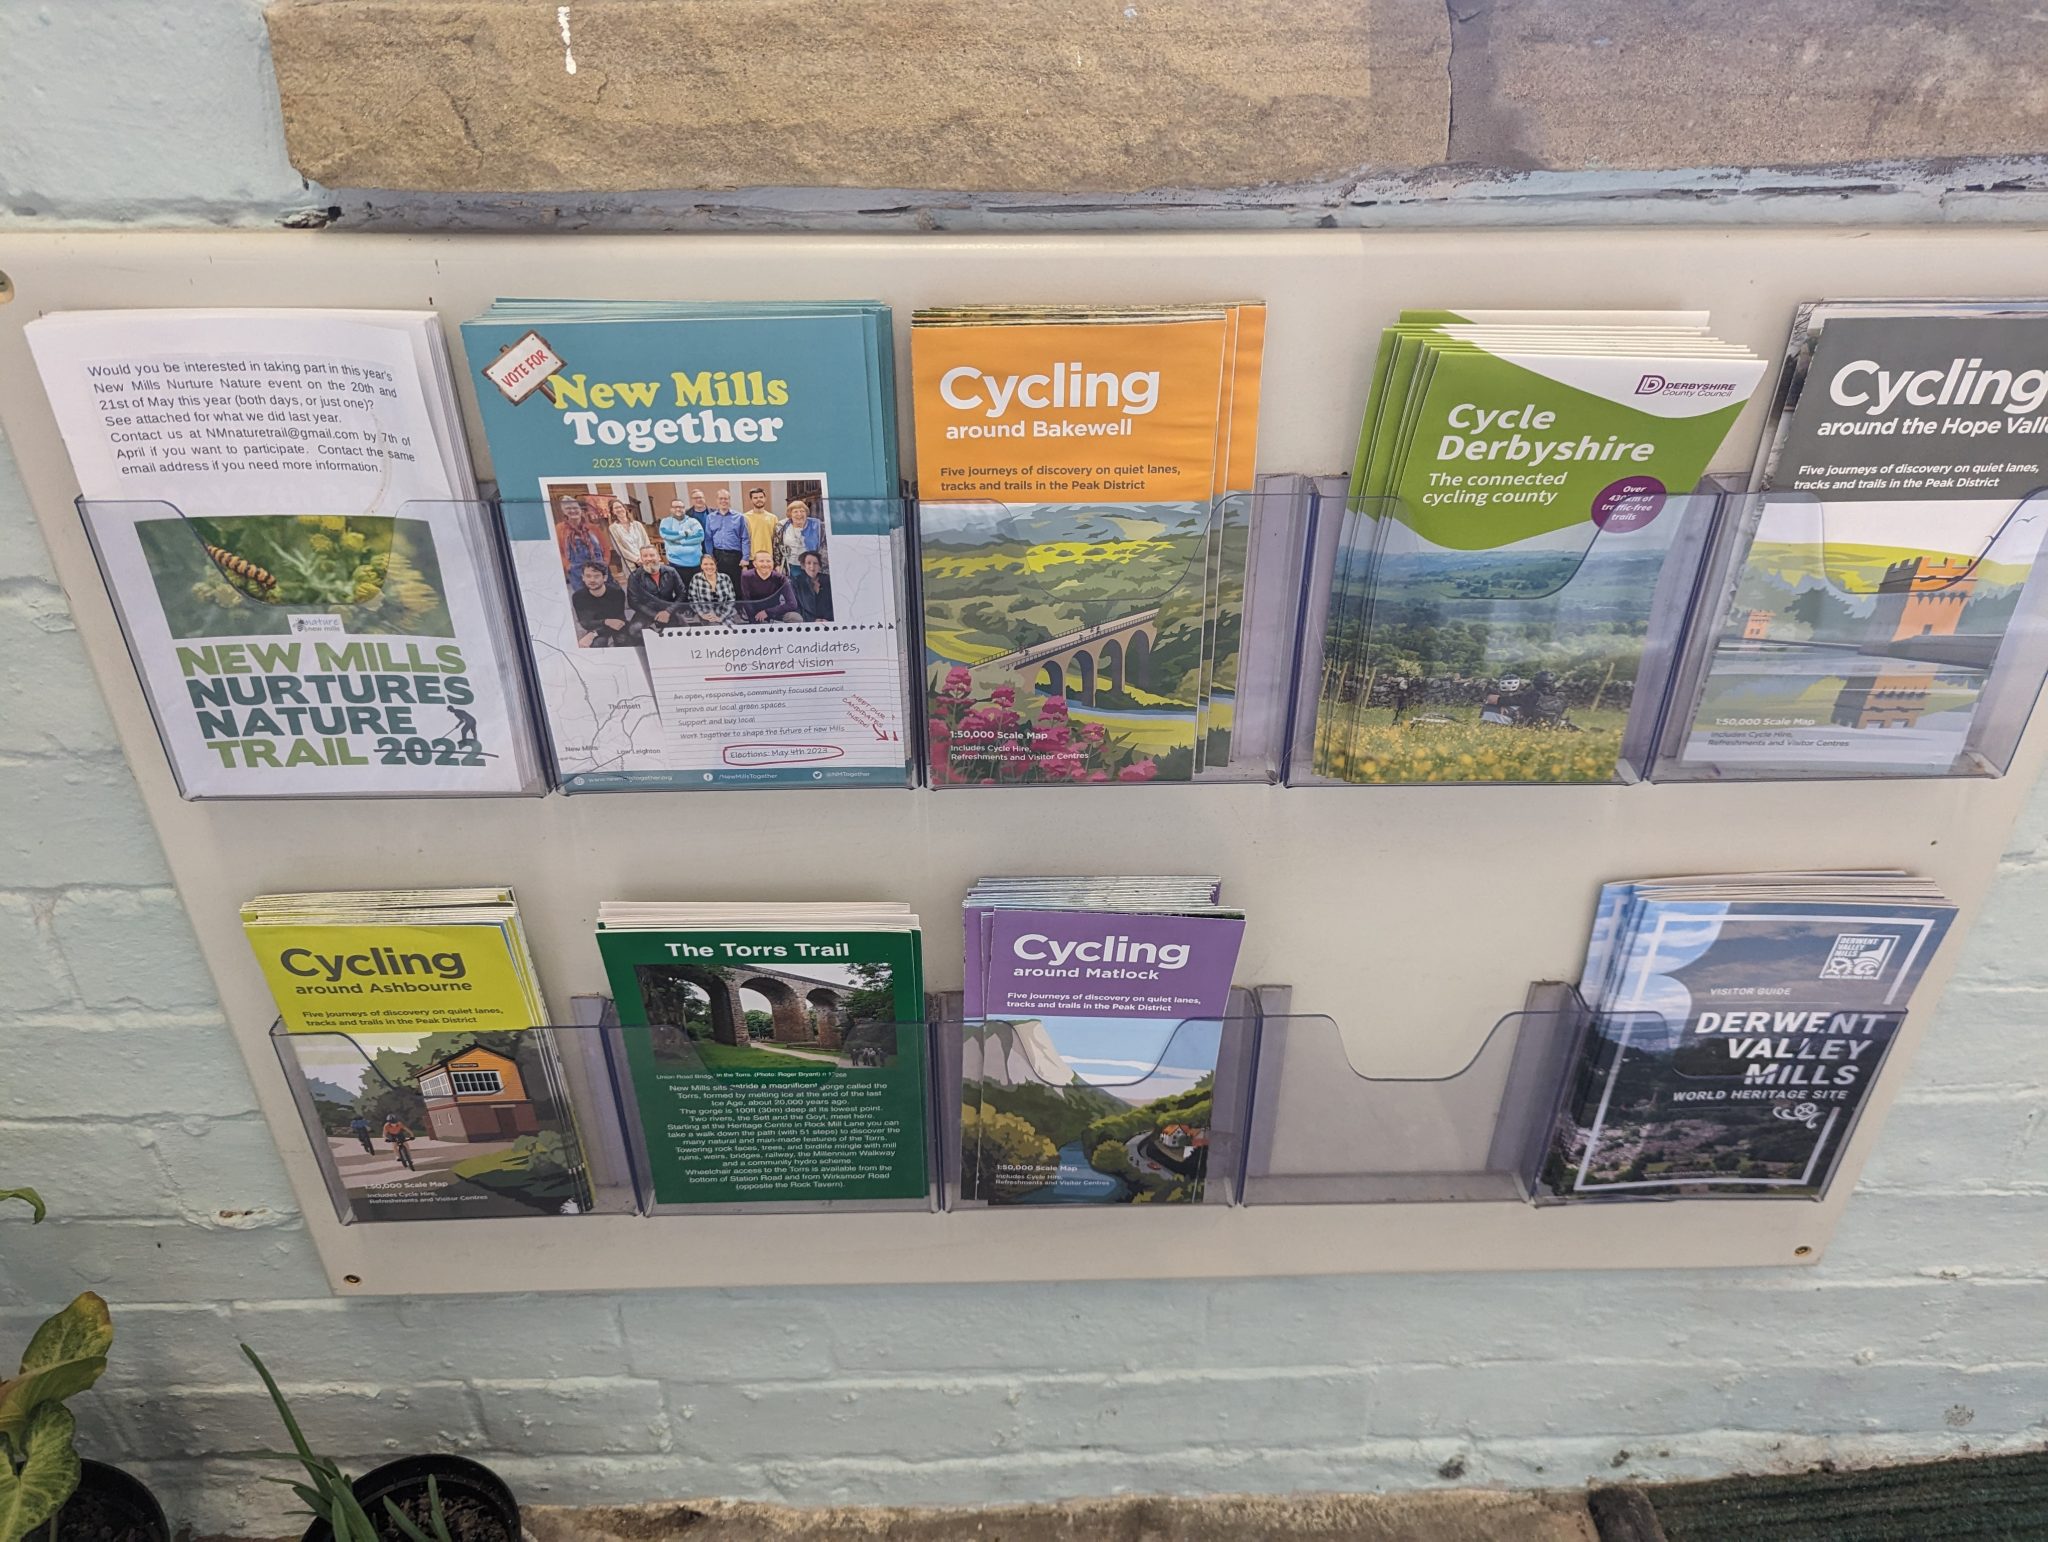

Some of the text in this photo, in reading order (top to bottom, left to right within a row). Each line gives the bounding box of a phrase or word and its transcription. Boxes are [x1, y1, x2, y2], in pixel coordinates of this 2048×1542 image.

[87, 361, 392, 382] Would you be interested in taking part in this year's
[501, 348, 549, 388] VOTE FOR
[547, 370, 789, 410] New Mills
[939, 362, 1160, 418] Cycling
[1662, 389, 1733, 398] County Council
[1665, 382, 1736, 391] DERBYSHIRE
[1829, 358, 2048, 416] Cycling
[100, 394, 374, 410] 21st of May this year (both days, or just one)?
[105, 410, 342, 427] See attached for what we did last year.
[1448, 403, 1556, 435] Cycle
[563, 409, 783, 453] Together
[946, 418, 1132, 440] around Bakewell
[1817, 418, 1898, 435] around
[1902, 418, 1937, 434] the
[1941, 417, 2001, 437] Hope
[110, 427, 411, 446] Contact us at NMnaturetrail@gmail.com by 7th of
[1437, 435, 1654, 466] Derbyshire
[592, 455, 760, 469] 2023 Town Council Elections
[1799, 465, 1825, 475] Five
[1827, 465, 1878, 477] journeys
[1880, 464, 1894, 474] of
[1895, 464, 1952, 475] discovery
[1972, 463, 2003, 474] quiet
[2005, 463, 2039, 474] lanes,
[941, 464, 1181, 479] Five journeys of discovery on quiet lanes,
[1428, 472, 1568, 486] The connected
[941, 479, 1145, 491] tracks and trails in the Peak District
[1622, 486, 1647, 494] Over
[1422, 490, 1558, 506] cycling county
[1611, 513, 1636, 521] trails
[176, 642, 467, 676] NEW MILLS
[691, 641, 860, 661] 12 Independent Candidates,
[724, 658, 833, 672] One Shared Vision
[186, 675, 475, 709] NURTURES
[196, 706, 417, 739] NATURE
[1716, 718, 1815, 726] 1:50,000 Scale Map
[950, 731, 1048, 740] 1:50,000 Scale Map
[207, 737, 486, 768] TRAIL 2022
[771, 748, 789, 757] May
[664, 942, 849, 956] The Torrs Trail
[1014, 933, 1190, 969] Cycling
[281, 947, 466, 981] Cycling
[1014, 968, 1159, 980] around Matlock
[296, 982, 472, 995] around Ashbourne
[1710, 987, 1791, 996] VISITOR GUIDE
[1030, 992, 1070, 1001] journeys
[1085, 994, 1130, 1002] discovery
[1147, 996, 1171, 1004] quiet
[1174, 997, 1201, 1005] lanes,
[326, 1010, 368, 1018] journeys
[383, 1010, 429, 1018] discovery
[448, 1008, 472, 1017] quiet
[475, 1007, 503, 1015] lanes,
[1694, 1012, 1886, 1034] DERWENT
[1728, 1038, 1872, 1060] VALLEY
[1744, 1064, 1859, 1085] MILLS
[1673, 1090, 1849, 1100] WORLD HERITAGE SITE
[791, 1181, 810, 1189] Rock
